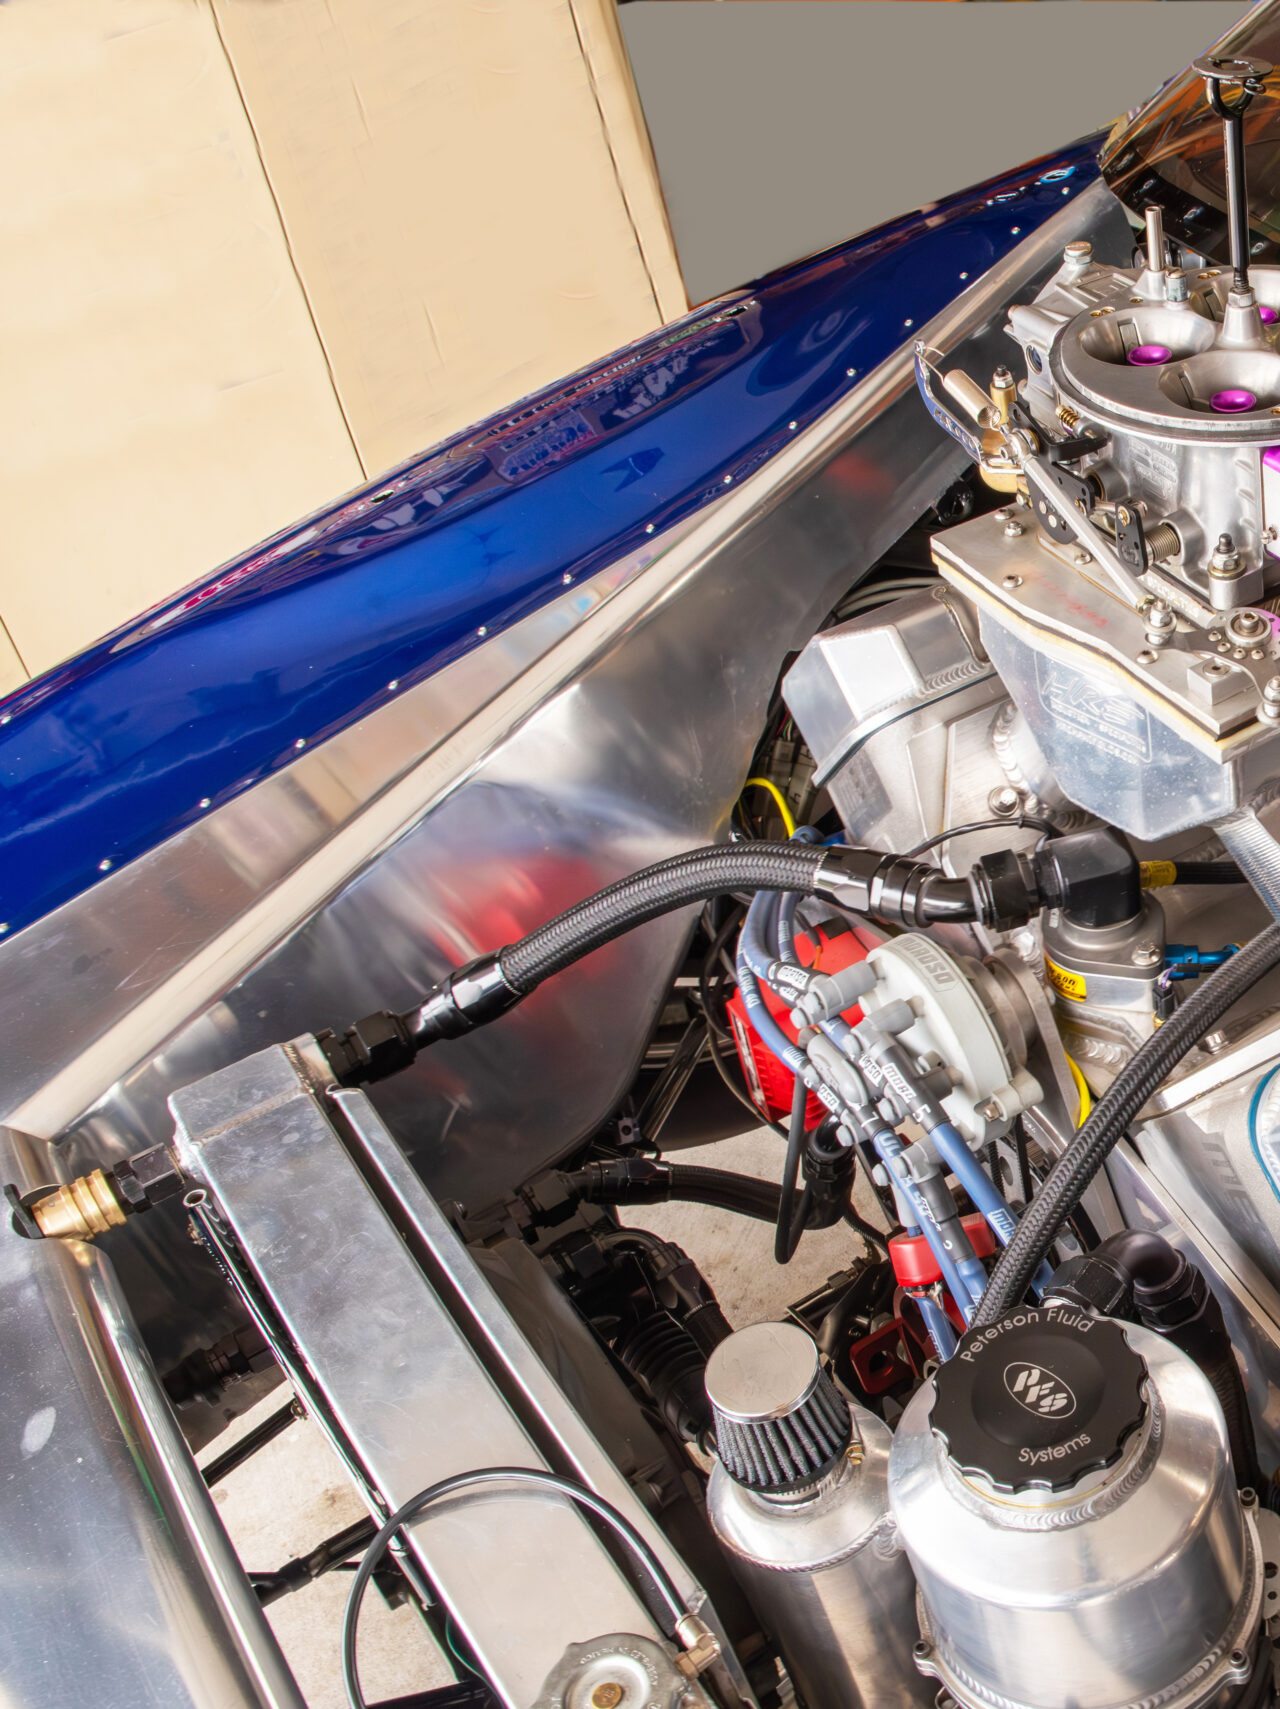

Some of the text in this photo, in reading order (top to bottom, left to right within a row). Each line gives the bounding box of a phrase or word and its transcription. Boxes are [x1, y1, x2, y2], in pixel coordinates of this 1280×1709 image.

[960, 1312, 1039, 1362] Peterson
[1046, 1308, 1096, 1333] Fluid
[1018, 1433, 1092, 1466] Systems
